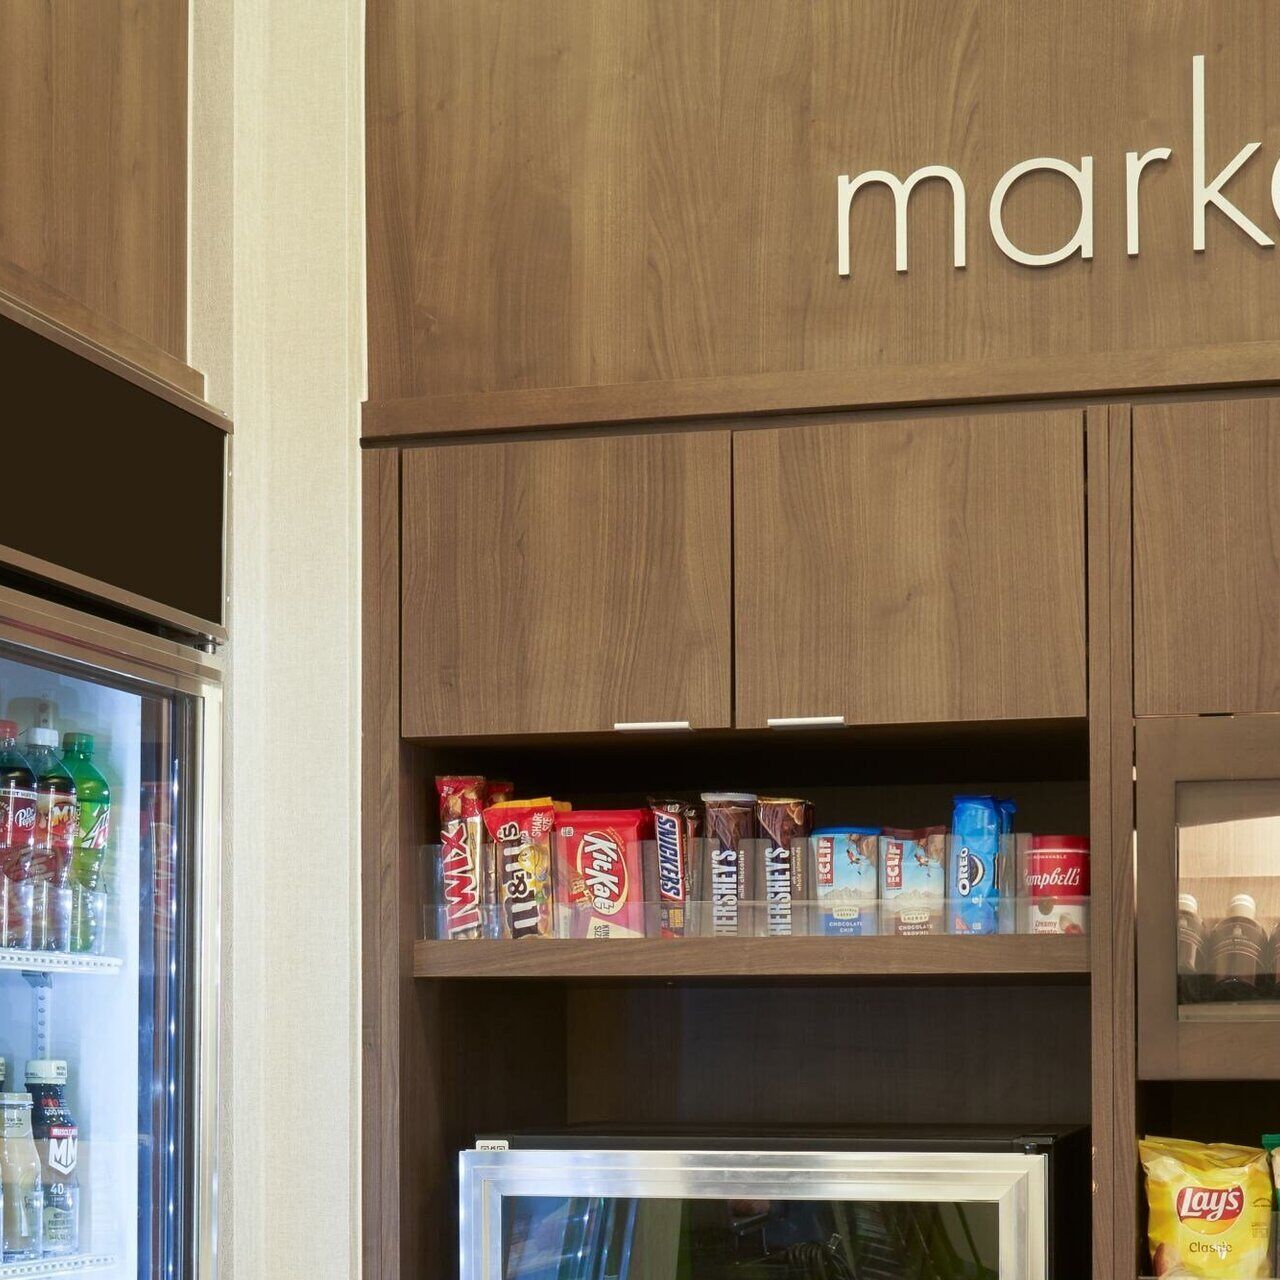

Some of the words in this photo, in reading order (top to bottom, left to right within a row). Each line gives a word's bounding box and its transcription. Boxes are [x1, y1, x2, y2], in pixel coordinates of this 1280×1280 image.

[531, 812, 544, 837] SHARE
[440, 822, 481, 933] TWIX
[656, 814, 681, 899] SNICKERS
[888, 844, 902, 876] CLIF
[958, 847, 970, 897] OREO
[712, 849, 738, 937] HERSHEY'S
[765, 847, 792, 936] HERSHEY'S
[50, 1183, 65, 1194] 40
[1180, 1185, 1242, 1222] Lay's
[1189, 1241, 1233, 1254] Classic
